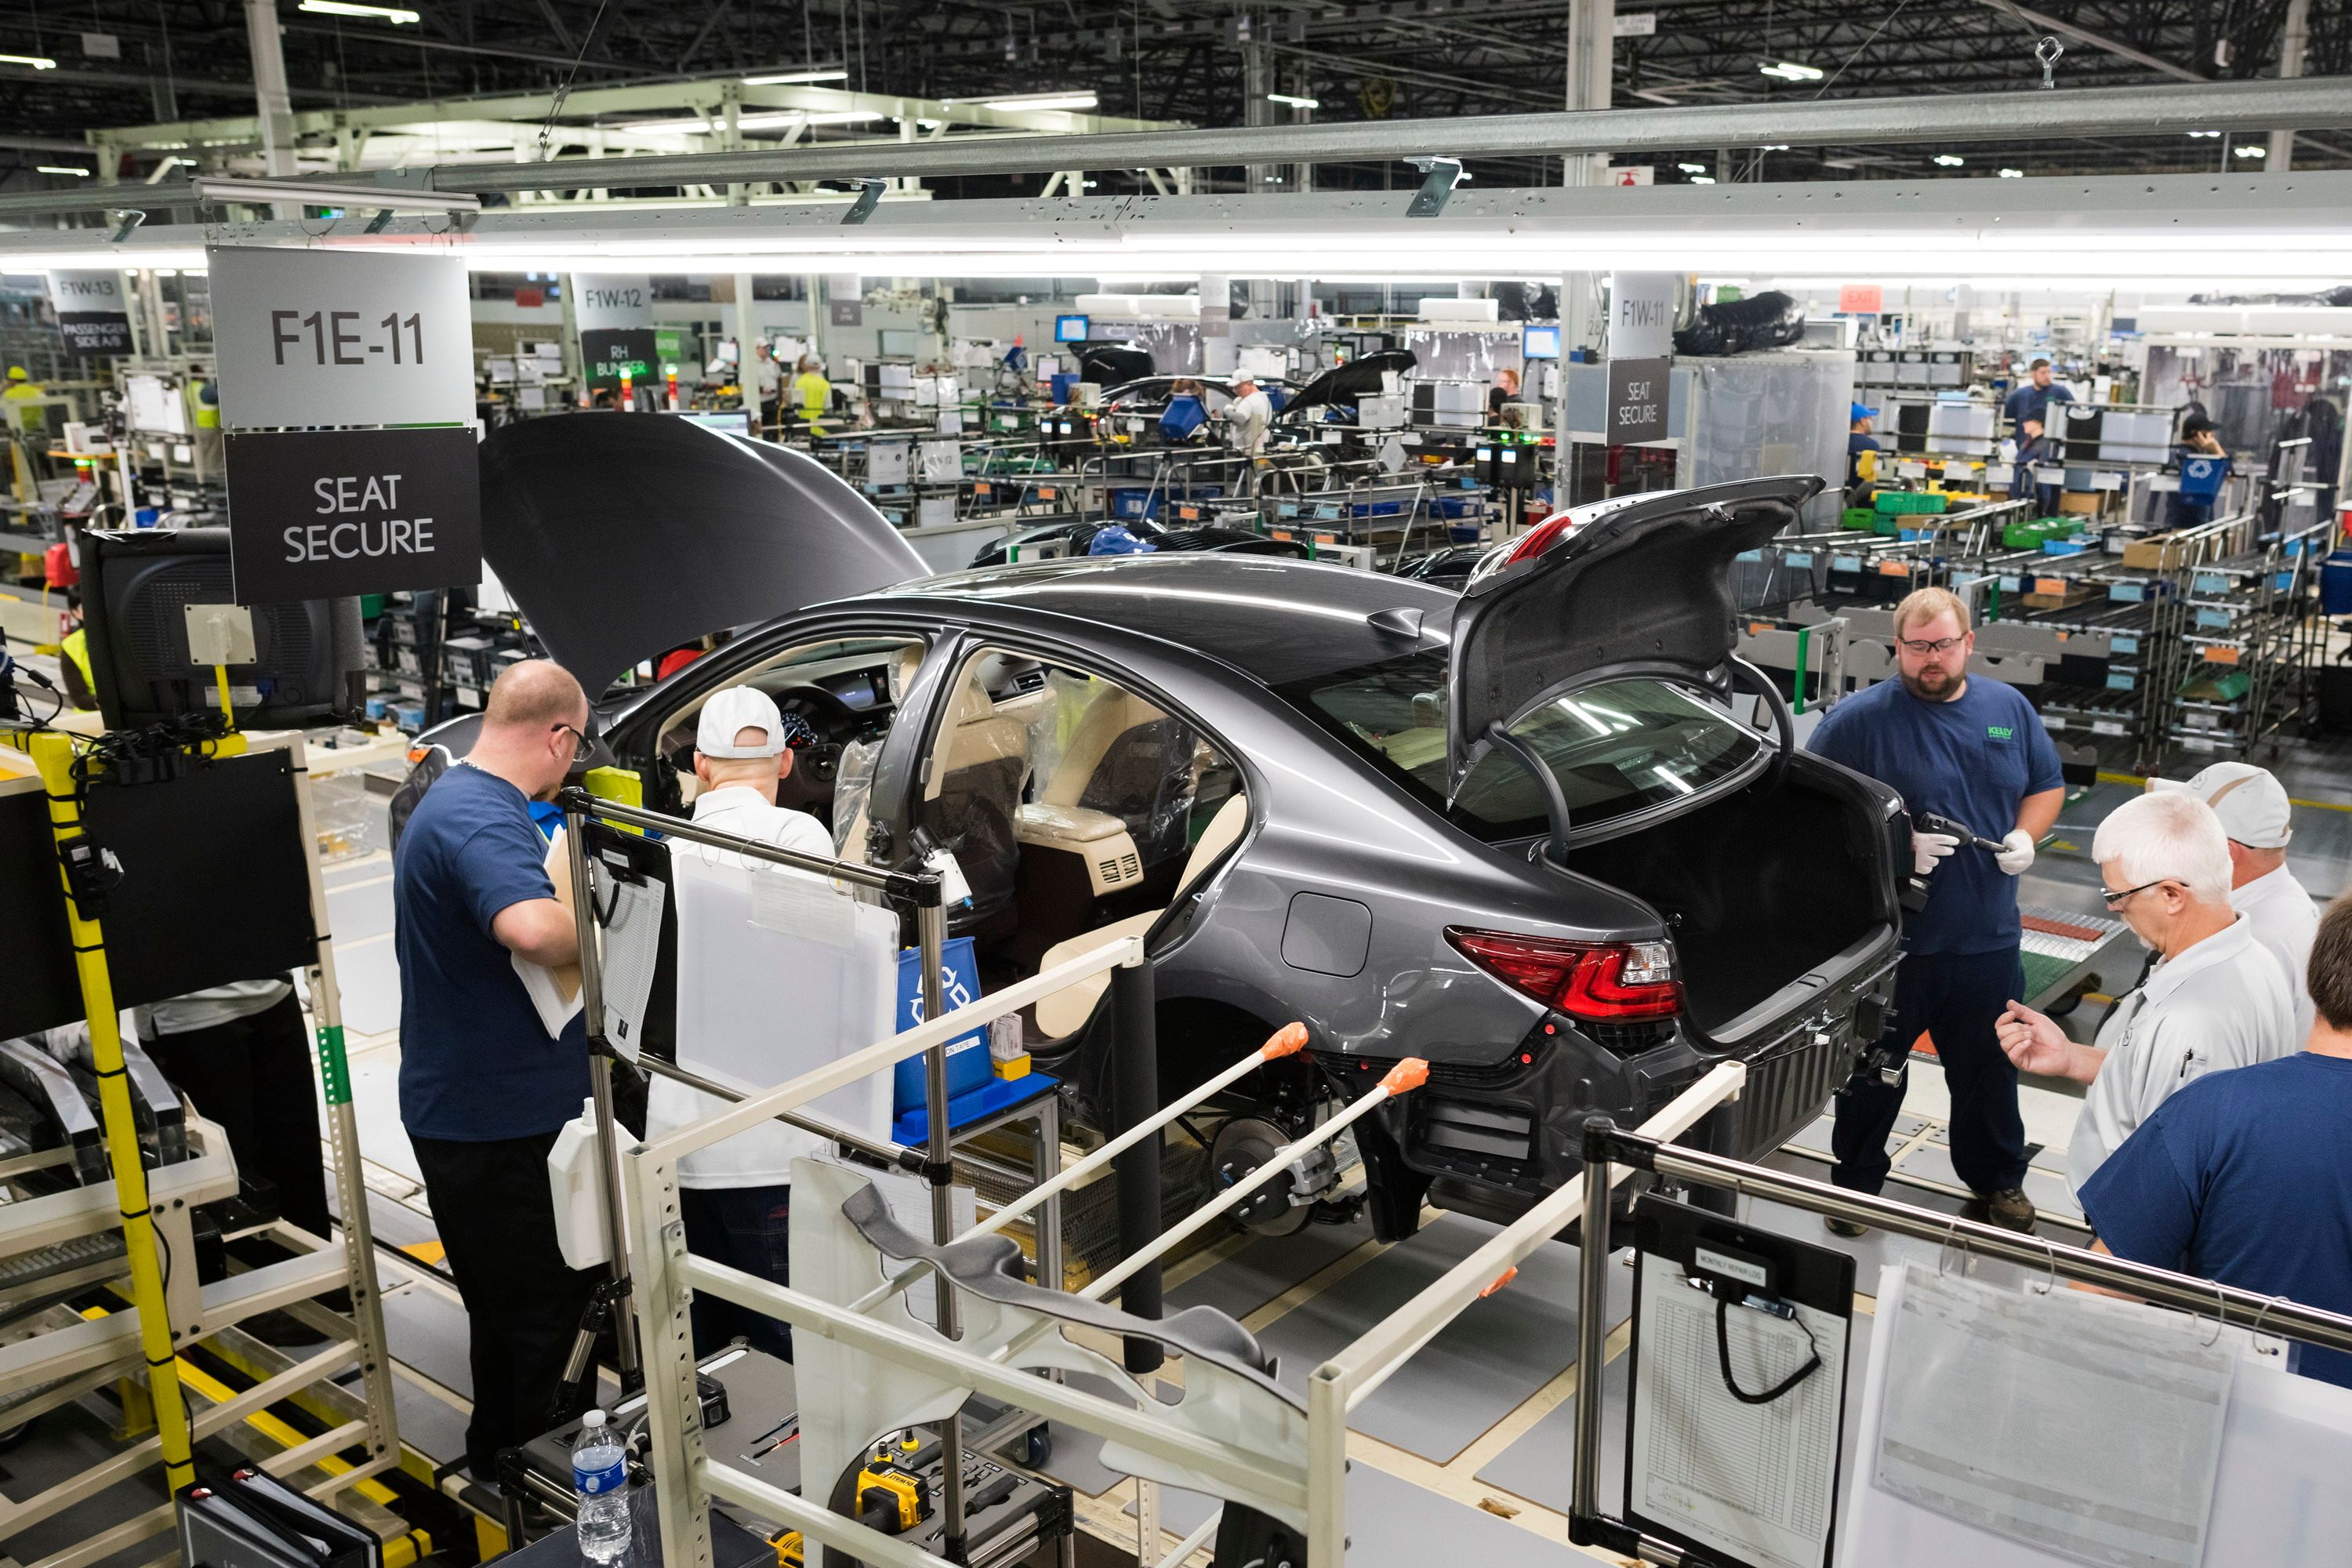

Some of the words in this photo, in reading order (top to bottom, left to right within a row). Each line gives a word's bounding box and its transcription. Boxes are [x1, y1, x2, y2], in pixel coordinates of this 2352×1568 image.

[60, 280, 114, 296] F1W-13
[1848, 291, 1874, 303] EXIT
[586, 289, 642, 308] F1W-12
[1621, 299, 1664, 327] F1W-11
[271, 310, 423, 365] F1E-11
[1588, 320, 1601, 336] 28
[75, 336, 100, 348] SIDE
[611, 345, 629, 359] RH
[1628, 381, 1650, 401] SEAT
[1619, 405, 1657, 425] SECURE
[314, 474, 401, 514] SEAT
[283, 517, 435, 563] SECURE
[1827, 633, 1833, 655] 2
[1987, 726, 2013, 736] KELLY
[956, 1040, 971, 1051] TAPE
